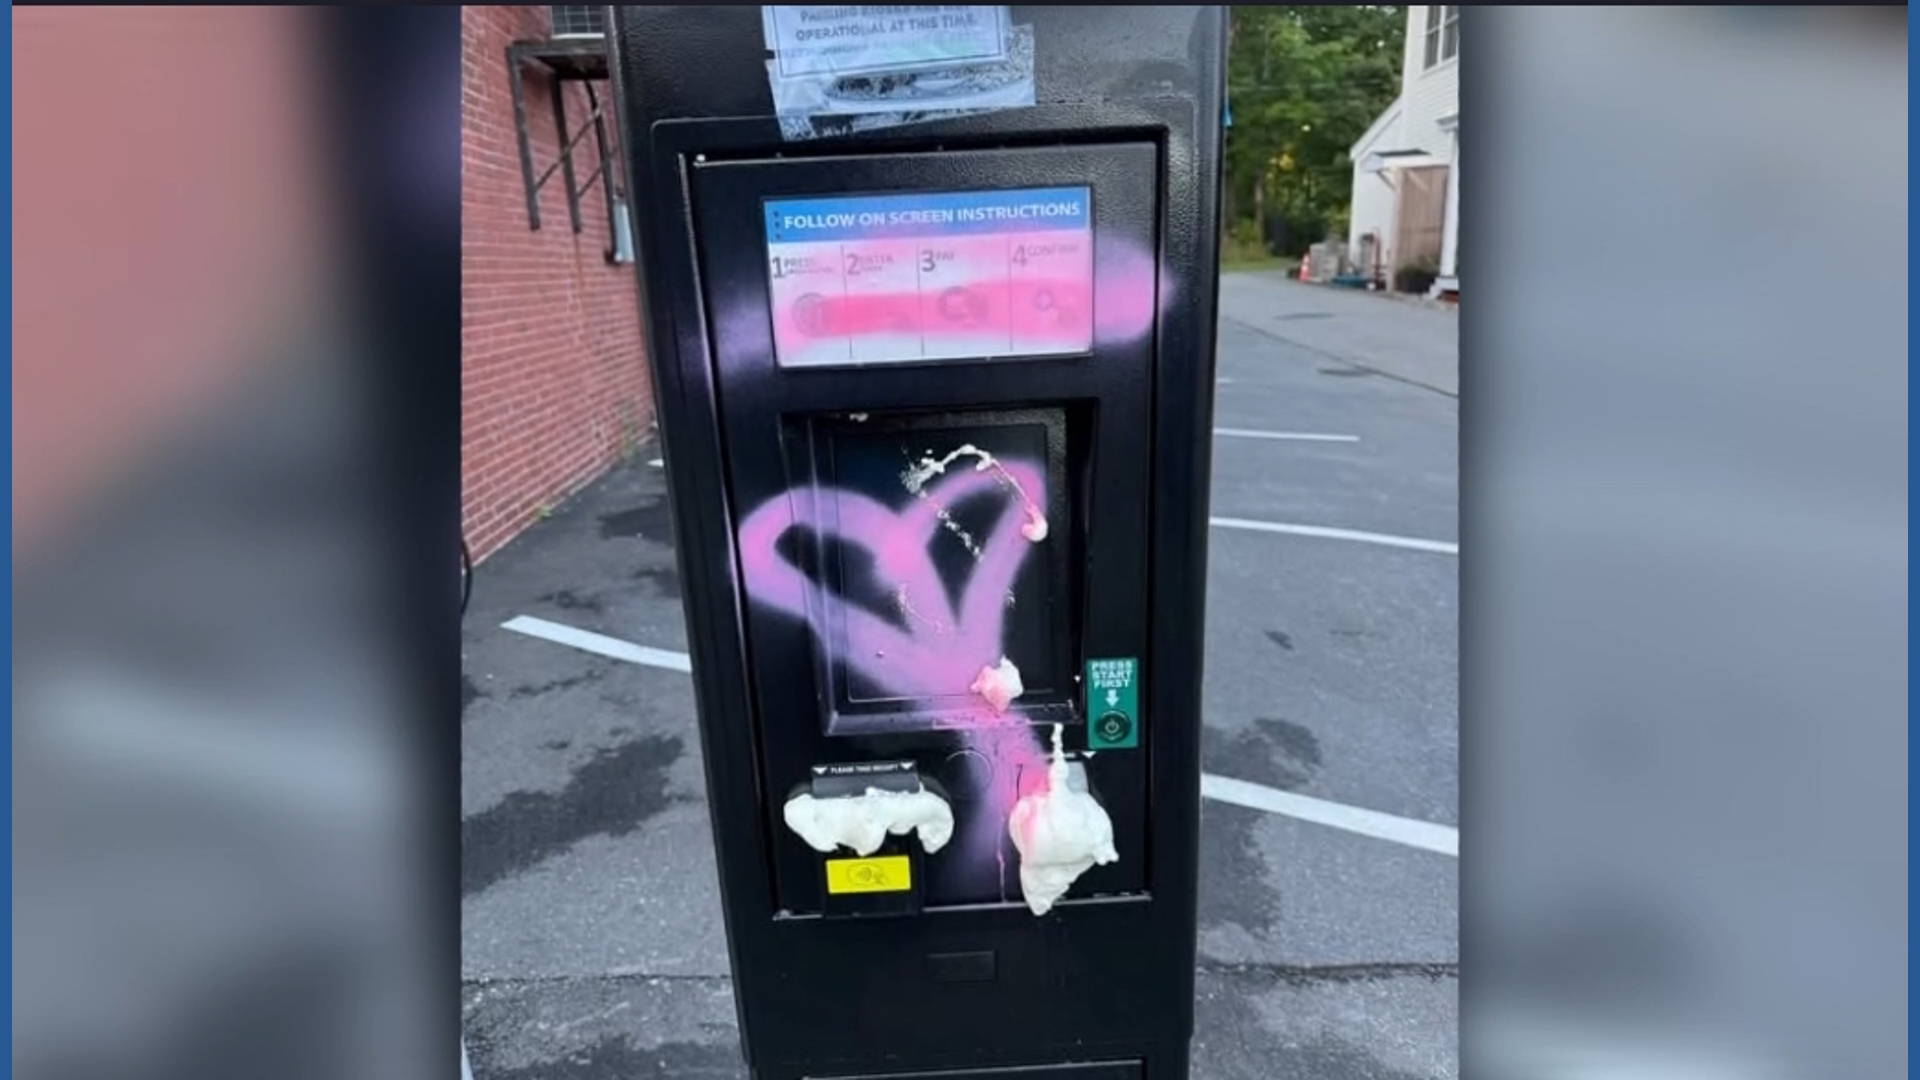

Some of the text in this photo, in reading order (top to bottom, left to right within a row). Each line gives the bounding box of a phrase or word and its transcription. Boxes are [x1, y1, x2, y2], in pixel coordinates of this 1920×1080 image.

[890, 19, 905, 32] AT
[909, 16, 938, 30] THIS
[784, 201, 1081, 229] FOLLOW ON SCREEN INSTRUCTIONS
[846, 253, 860, 276] 2
[921, 249, 936, 272] 3
[1012, 244, 1027, 266] 4
[772, 256, 785, 279] 1
[1091, 660, 1132, 671] PRESS
[1091, 671, 1131, 680] START
[1093, 680, 1129, 690] FIRST
